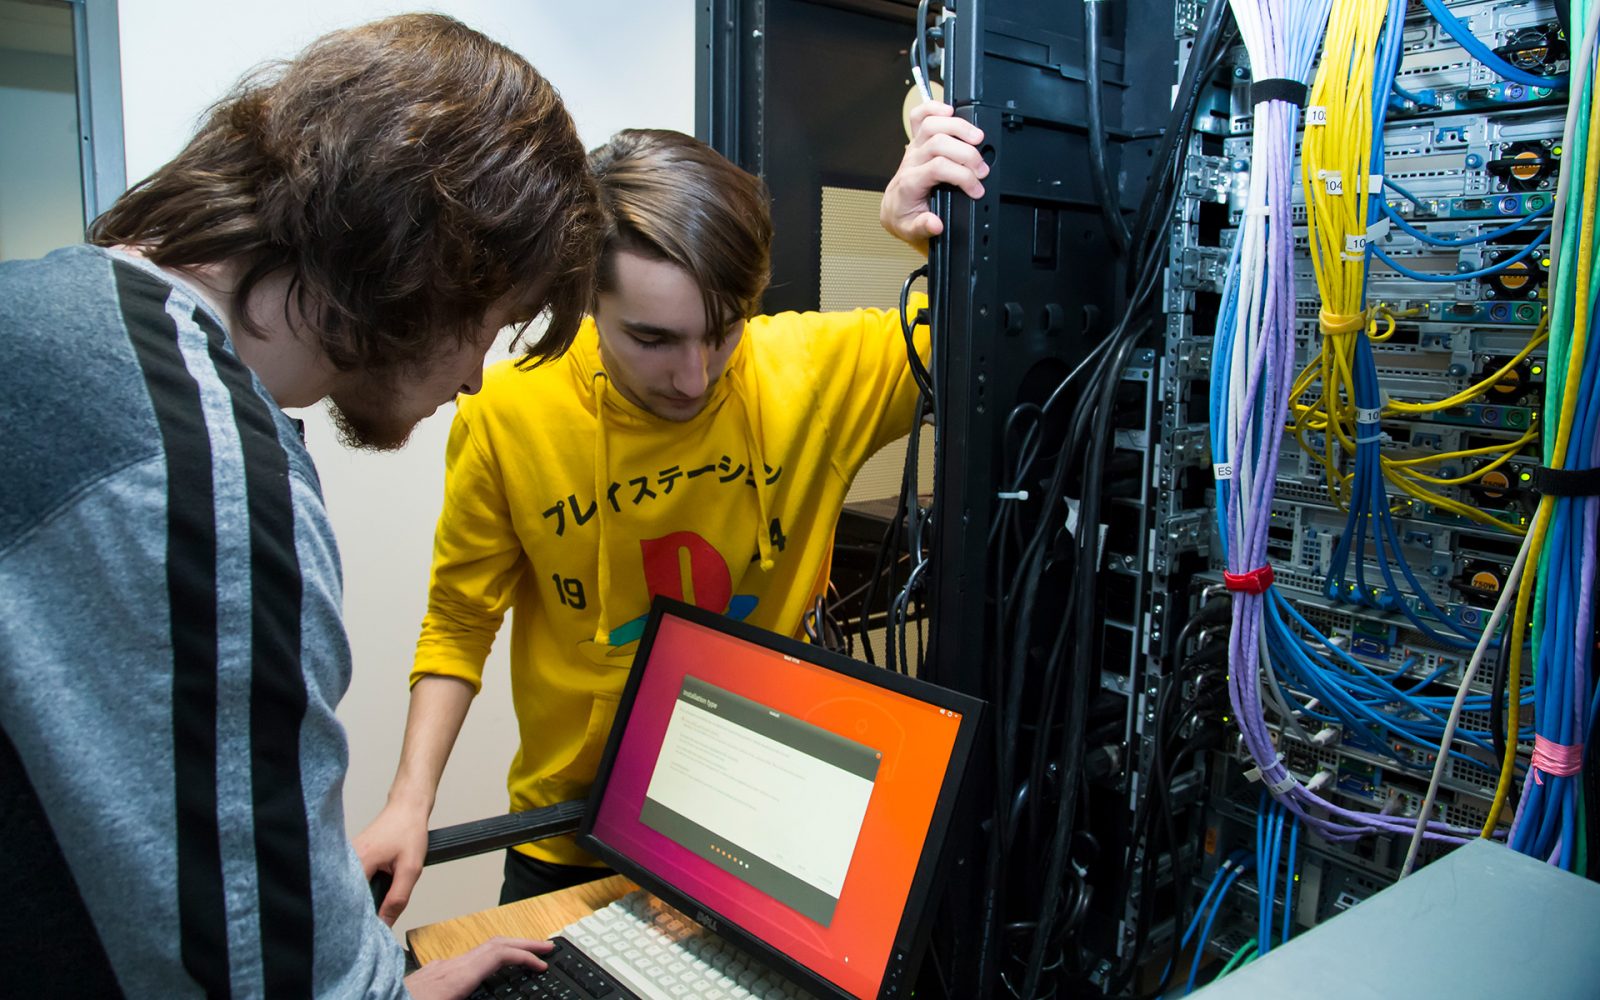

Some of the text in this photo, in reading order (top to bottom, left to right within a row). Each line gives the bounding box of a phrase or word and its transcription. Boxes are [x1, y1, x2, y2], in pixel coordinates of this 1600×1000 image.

[1218, 466, 1232, 476] ES
[542, 455, 783, 537] プレイステーシン
[552, 573, 587, 610] 19
[707, 699, 718, 709] type
